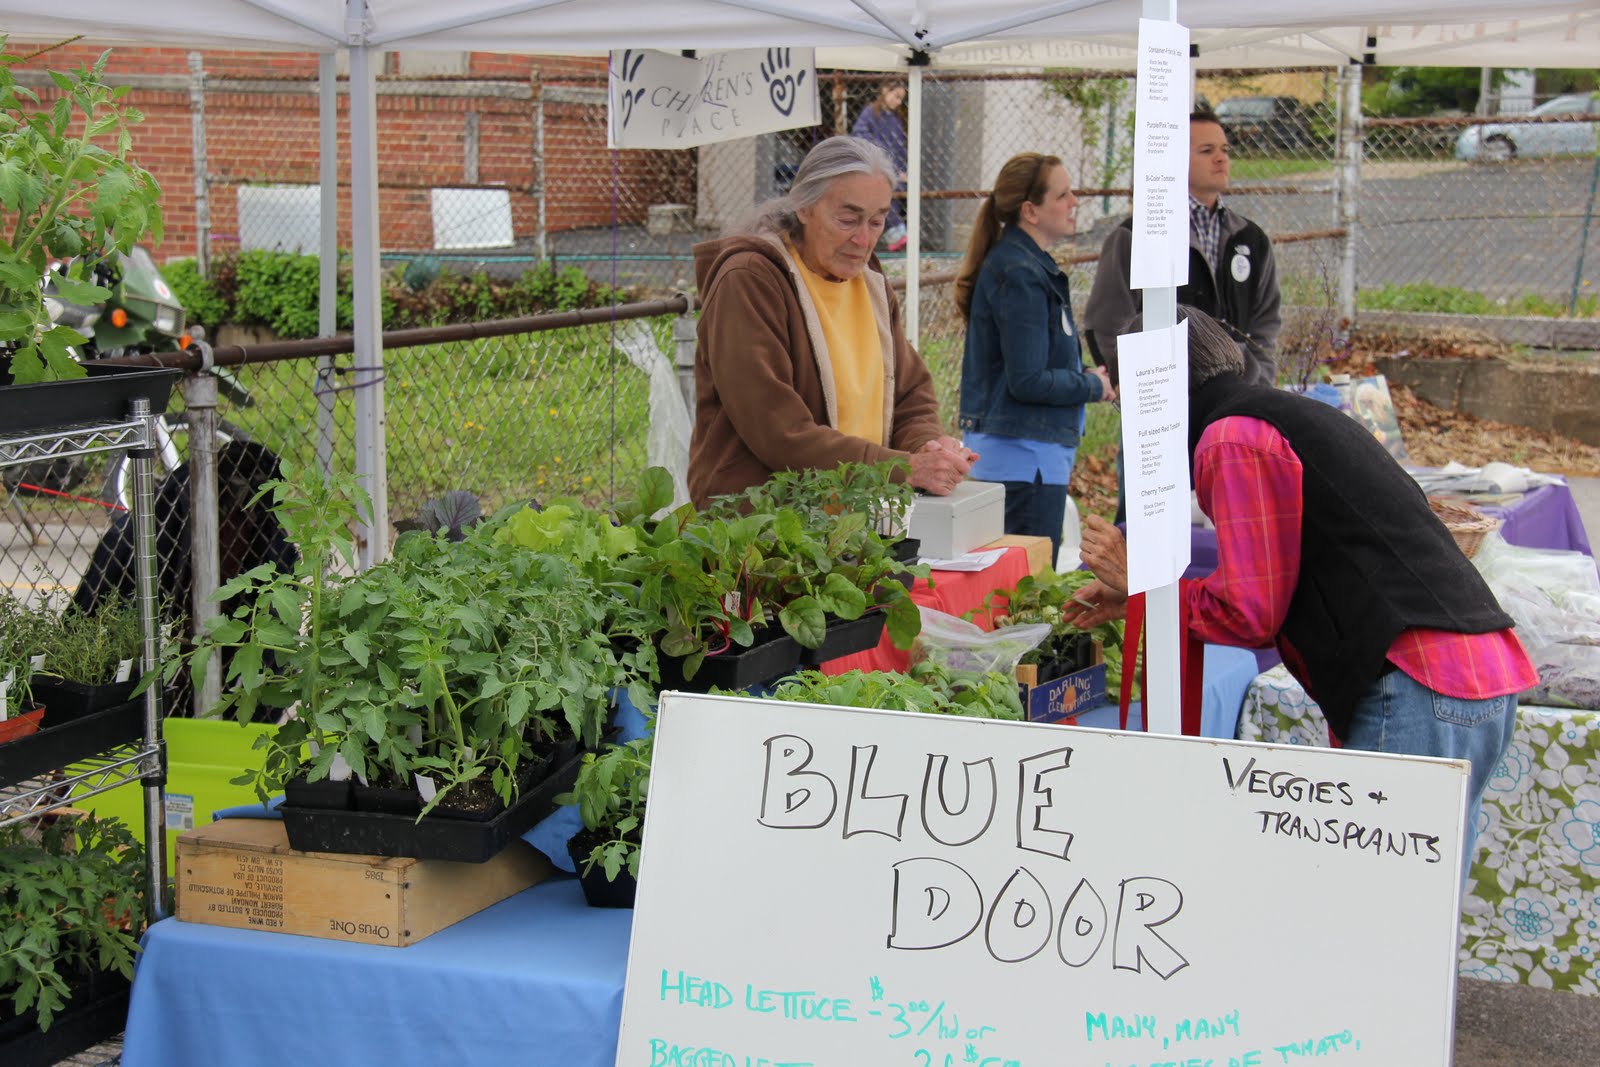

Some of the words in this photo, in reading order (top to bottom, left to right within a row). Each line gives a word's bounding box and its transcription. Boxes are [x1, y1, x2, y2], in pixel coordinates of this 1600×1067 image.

[1135, 368, 1155, 377] Laura's
[1141, 489, 1157, 497] Cherry
[1049, 677, 1091, 702] DARLING
[1222, 757, 1354, 806] VEGGIES
[756, 734, 1075, 862] BLUE
[1254, 810, 1442, 864] TRANSPLANTS
[232, 871, 245, 880] USA
[256, 875, 283, 884] PRODUCT
[364, 869, 385, 881] 1985
[244, 881, 253, 889] CA
[226, 888, 234, 896] DE
[231, 897, 259, 908] MONDAVI
[263, 893, 283, 902] BARON
[208, 903, 216, 911] BY
[217, 904, 243, 914] BOTTLED
[260, 901, 283, 910] ROBERT
[252, 909, 283, 919] PRODUCED
[886, 856, 1190, 981] DOOR
[248, 916, 264, 925] WINE
[265, 918, 277, 927] RED
[330, 919, 357, 936] ONE
[358, 923, 390, 940] OPUS
[660, 968, 734, 1010] HEAD
[746, 983, 858, 1022] LETTUCE
[1085, 1010, 1169, 1050] MANY,
[1175, 1008, 1241, 1042] MANY
